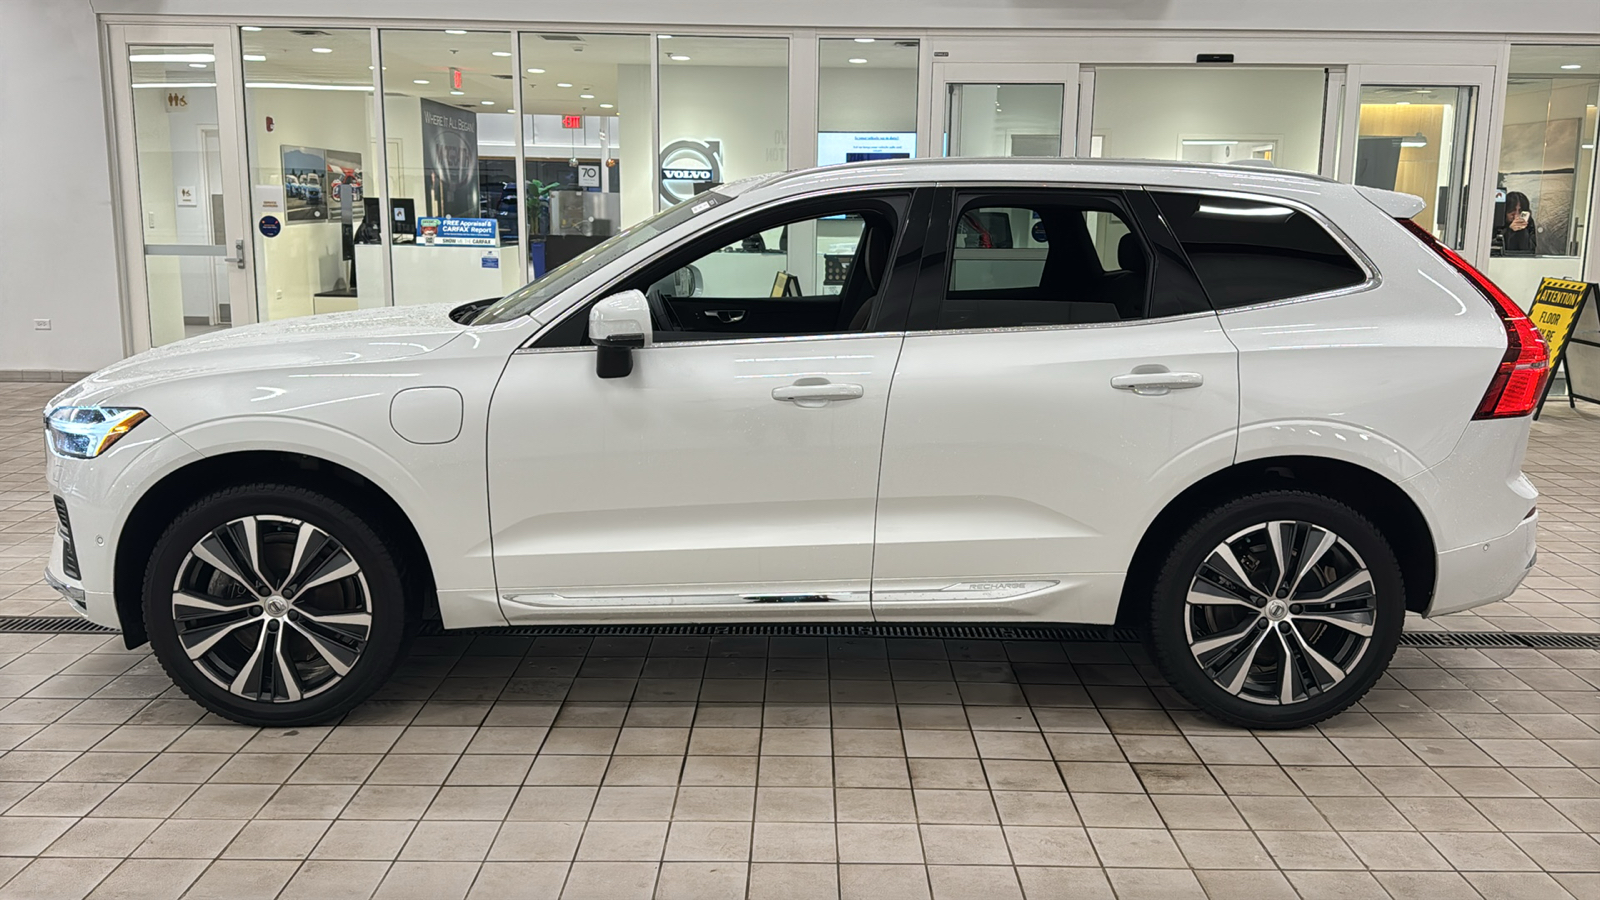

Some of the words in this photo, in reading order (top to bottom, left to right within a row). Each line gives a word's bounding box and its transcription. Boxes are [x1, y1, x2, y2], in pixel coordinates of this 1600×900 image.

[581, 167, 597, 178] 70
[663, 170, 711, 179] VOLVO
[460, 220, 486, 229] Appraisal
[470, 226, 492, 234] Report
[1541, 289, 1577, 306] ATTENTION
[1539, 311, 1561, 326] FLOOR
[969, 582, 1026, 590] RECHARGE
